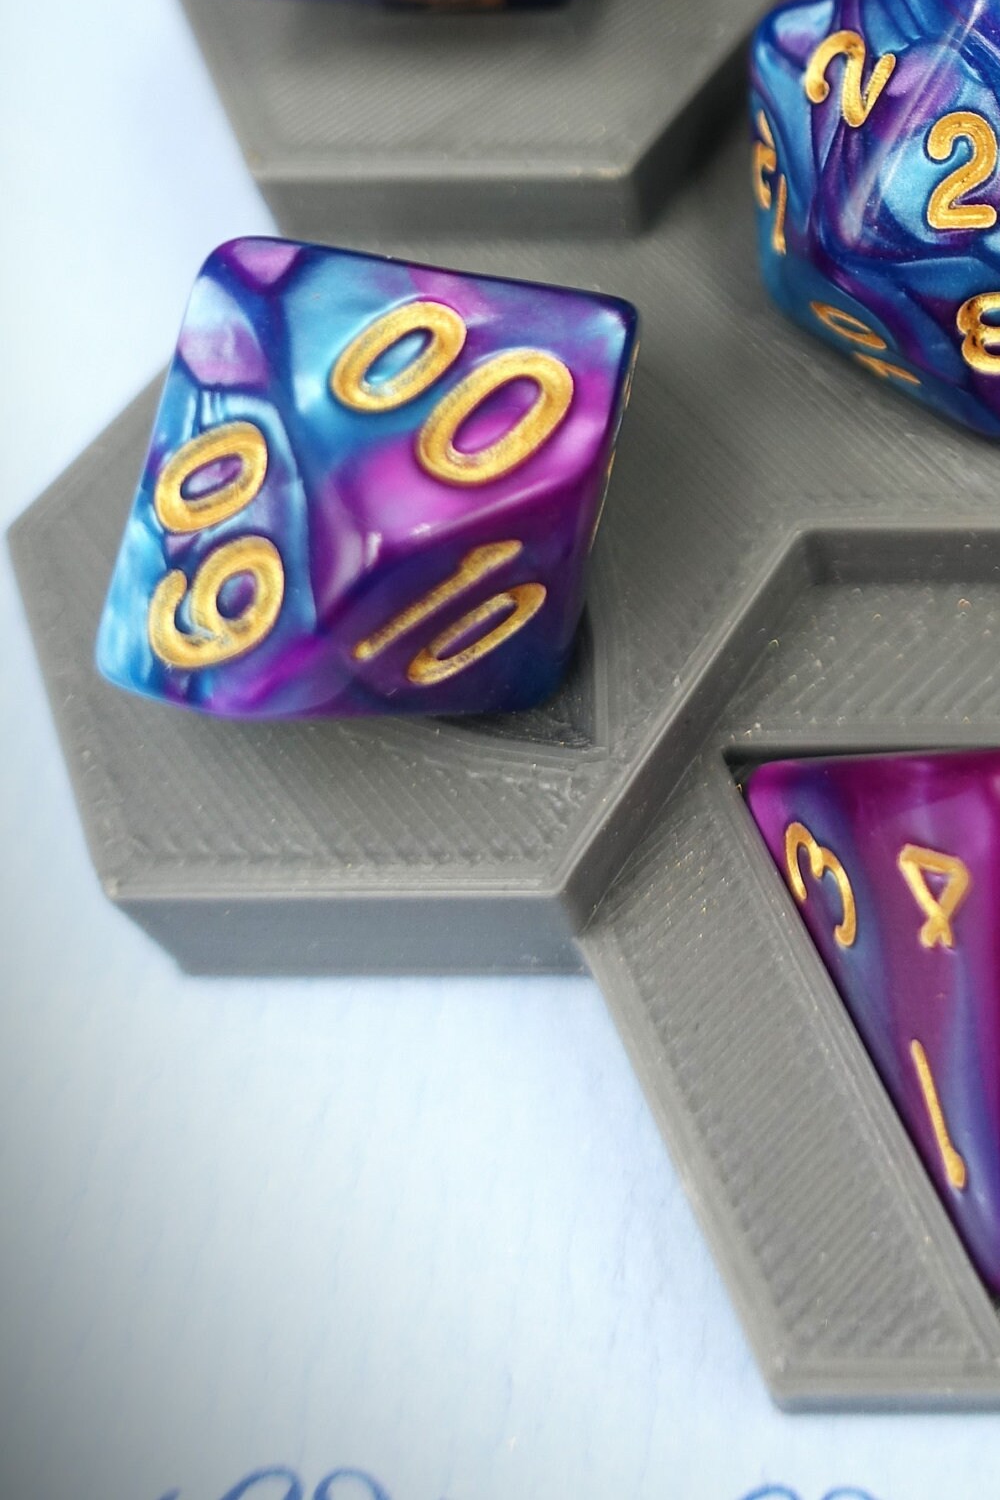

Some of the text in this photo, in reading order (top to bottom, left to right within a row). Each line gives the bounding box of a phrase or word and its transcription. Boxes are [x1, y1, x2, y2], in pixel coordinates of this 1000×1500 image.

[804, 30, 897, 129] 2
[330, 300, 575, 487] 00
[353, 539, 548, 686] 10
[784, 821, 858, 948] 3
[897, 843, 972, 950] 4
